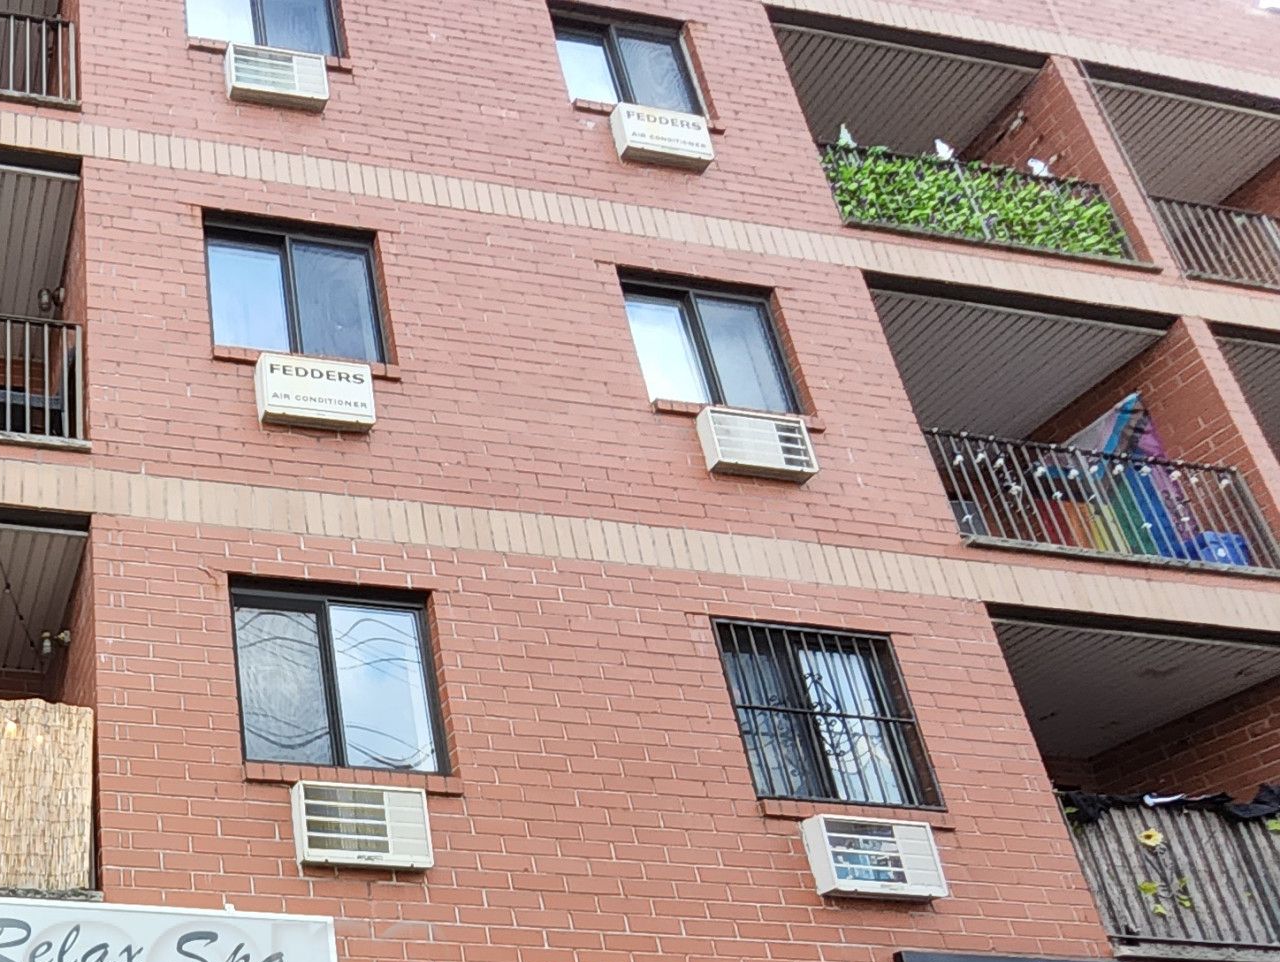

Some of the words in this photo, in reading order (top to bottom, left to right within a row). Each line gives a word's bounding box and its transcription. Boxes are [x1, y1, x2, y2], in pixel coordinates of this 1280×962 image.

[626, 110, 702, 131] FEDDERS
[269, 363, 365, 384] FEDDERS
[272, 392, 291, 400] AIR
[295, 394, 368, 409] CONDITIONER
